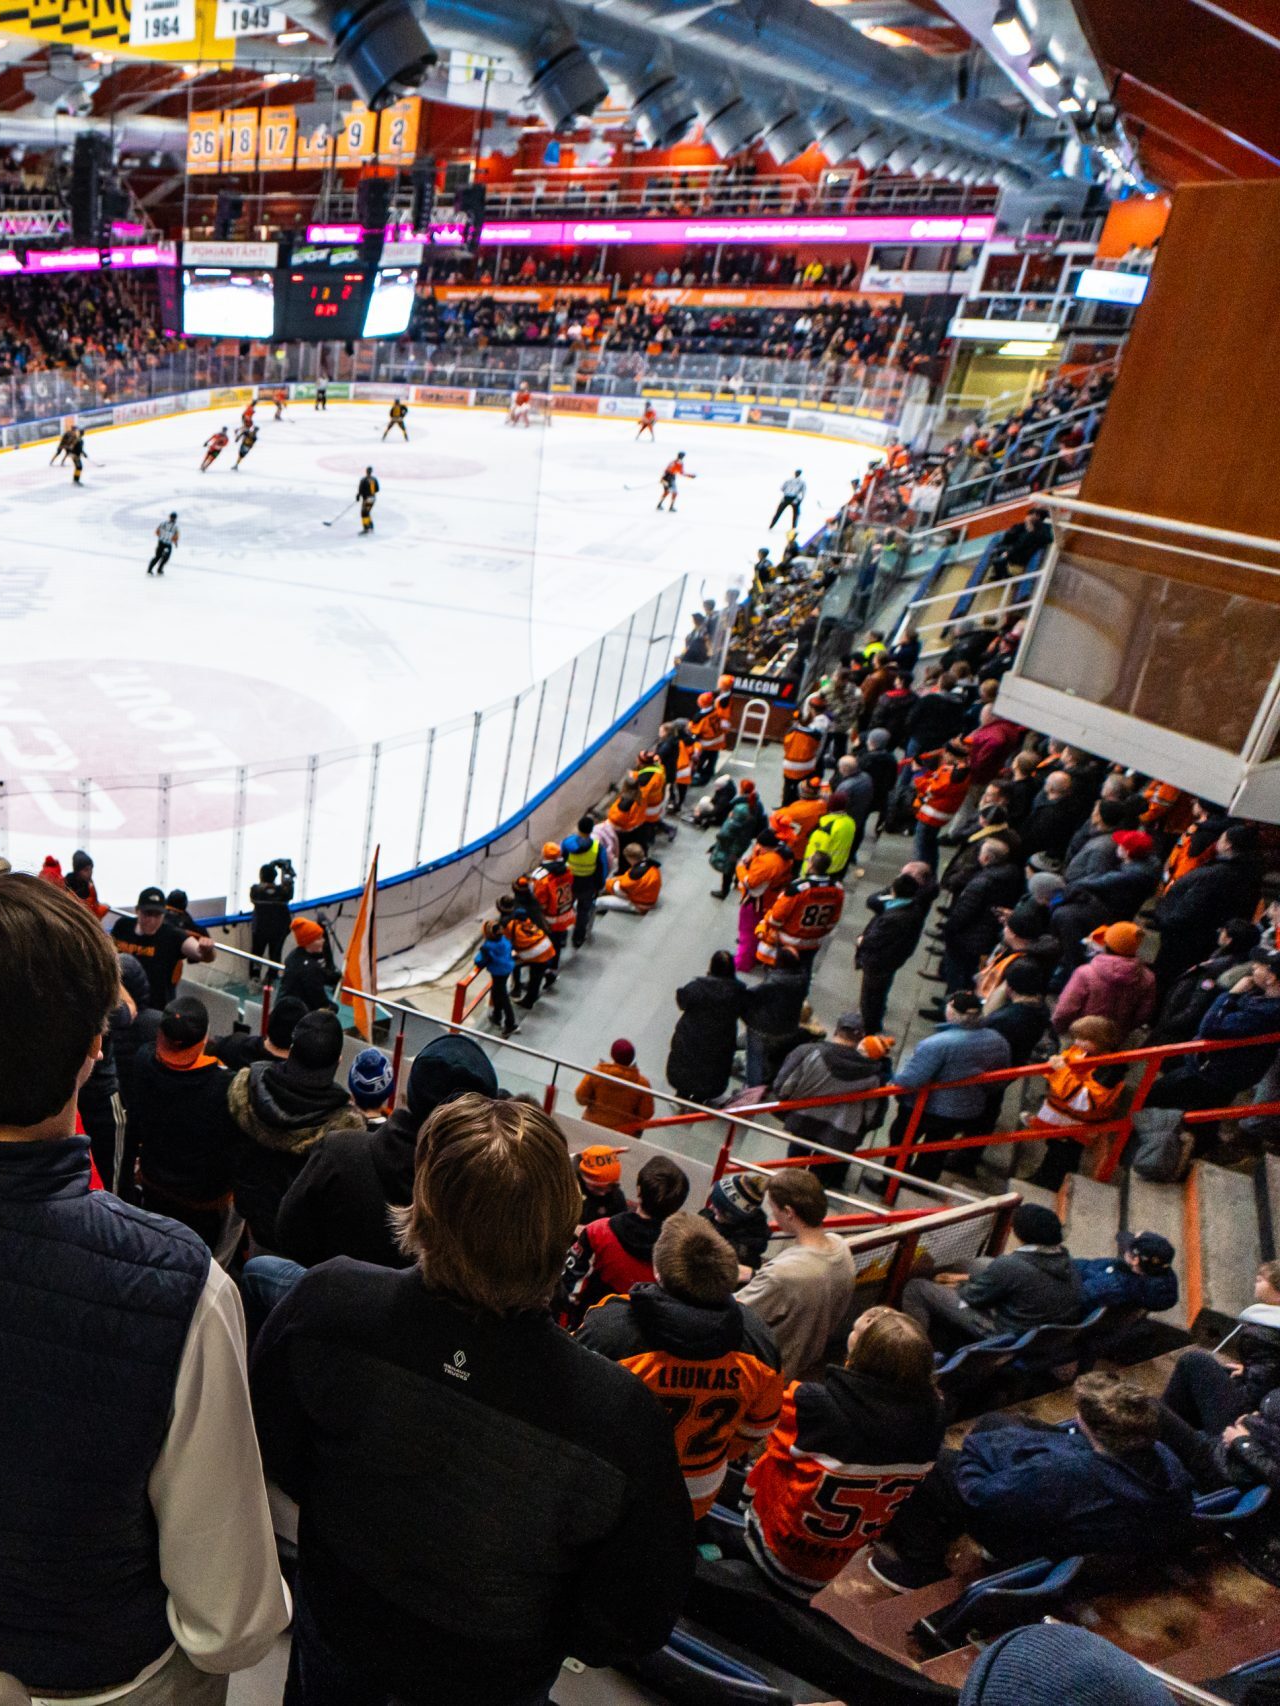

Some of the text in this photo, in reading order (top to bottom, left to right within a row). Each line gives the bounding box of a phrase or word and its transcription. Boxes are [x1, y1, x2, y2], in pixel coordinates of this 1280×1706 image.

[144, 16, 180, 38] 1964
[232, 8, 270, 31] 1949
[191, 131, 215, 154] 36
[267, 126, 289, 151] 17
[349, 122, 362, 147] 9
[391, 119, 405, 146] 2
[658, 1366, 742, 1390] LIUKAS
